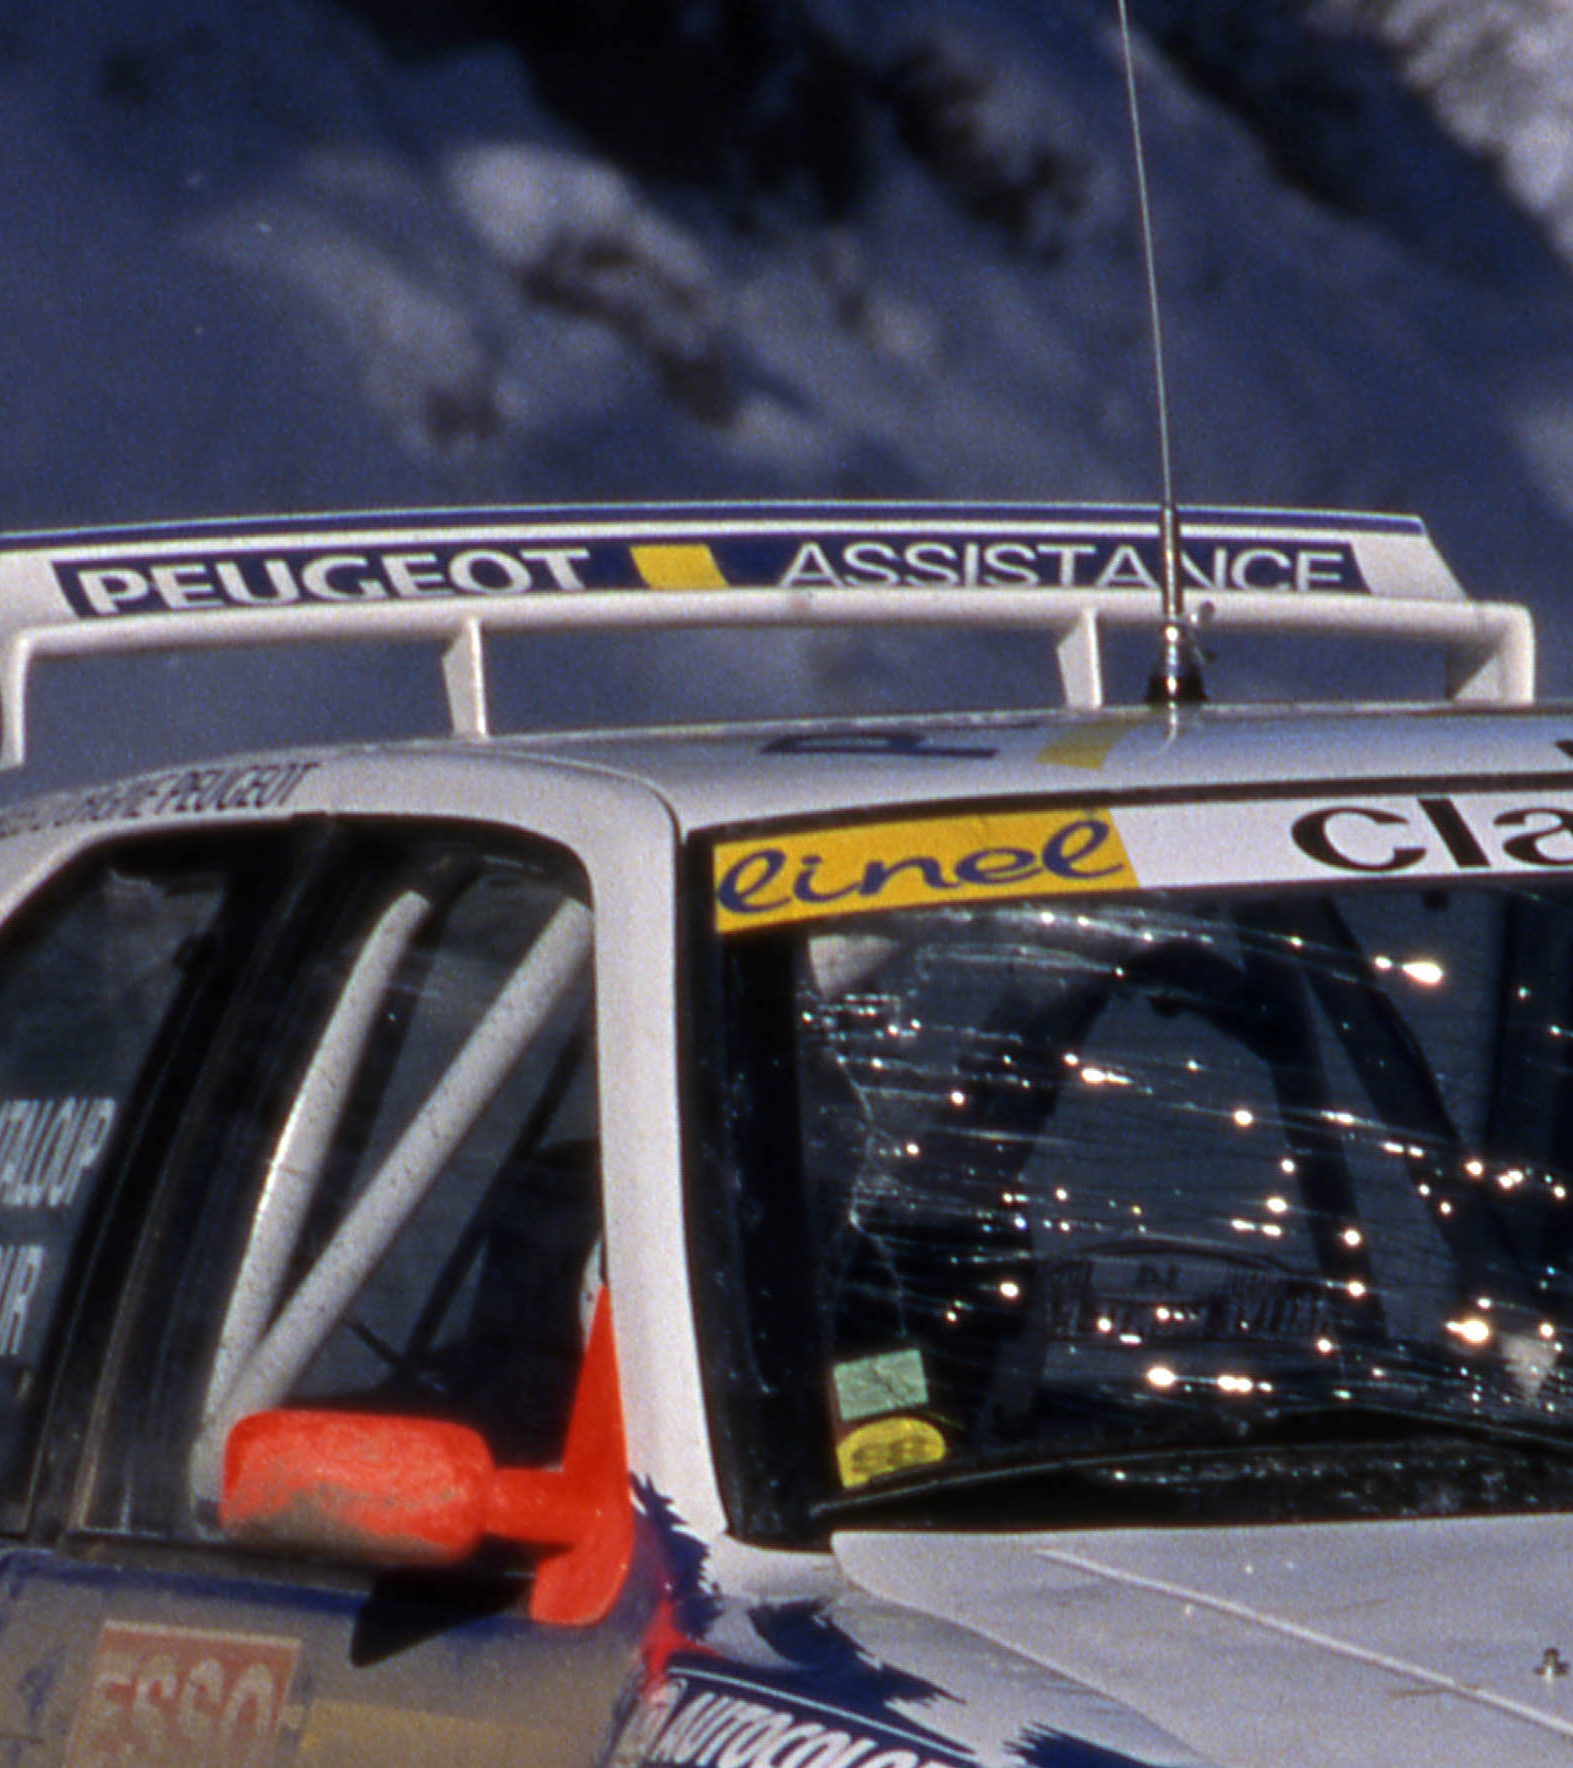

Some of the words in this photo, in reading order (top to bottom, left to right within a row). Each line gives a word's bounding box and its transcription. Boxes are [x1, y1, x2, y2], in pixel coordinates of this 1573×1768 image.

[77, 547, 591, 614] PEUGEOT
[780, 542, 1345, 593] ASSISTANCE
[716, 815, 1124, 914] linel
